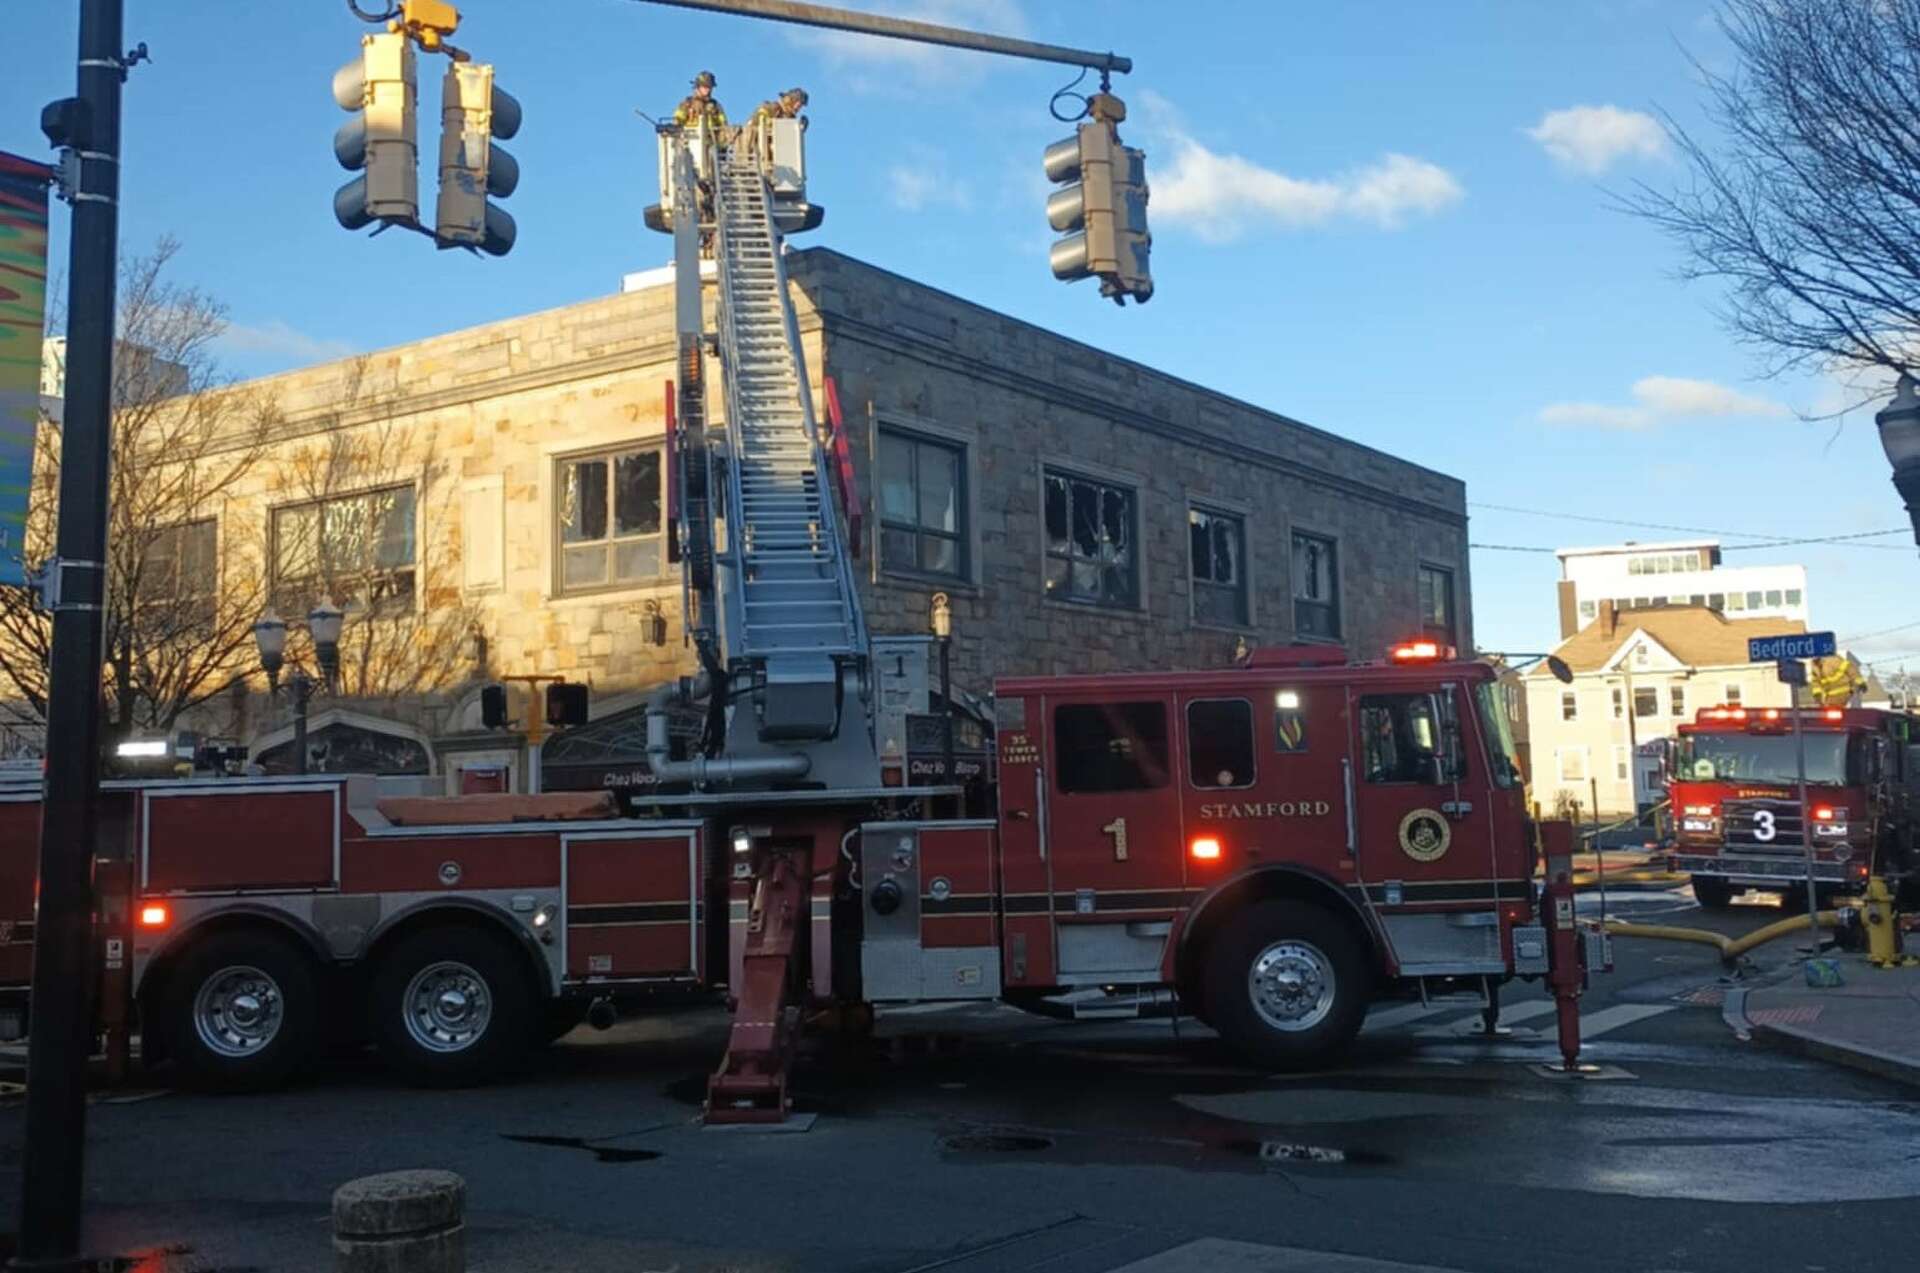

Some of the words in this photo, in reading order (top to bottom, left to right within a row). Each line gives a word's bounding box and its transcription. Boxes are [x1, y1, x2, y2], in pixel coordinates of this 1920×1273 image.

[1751, 638, 1815, 659] Bedford
[1200, 801, 1330, 819] STAMFORD
[1753, 809, 1776, 841] 3
[1103, 817, 1128, 861] 1
